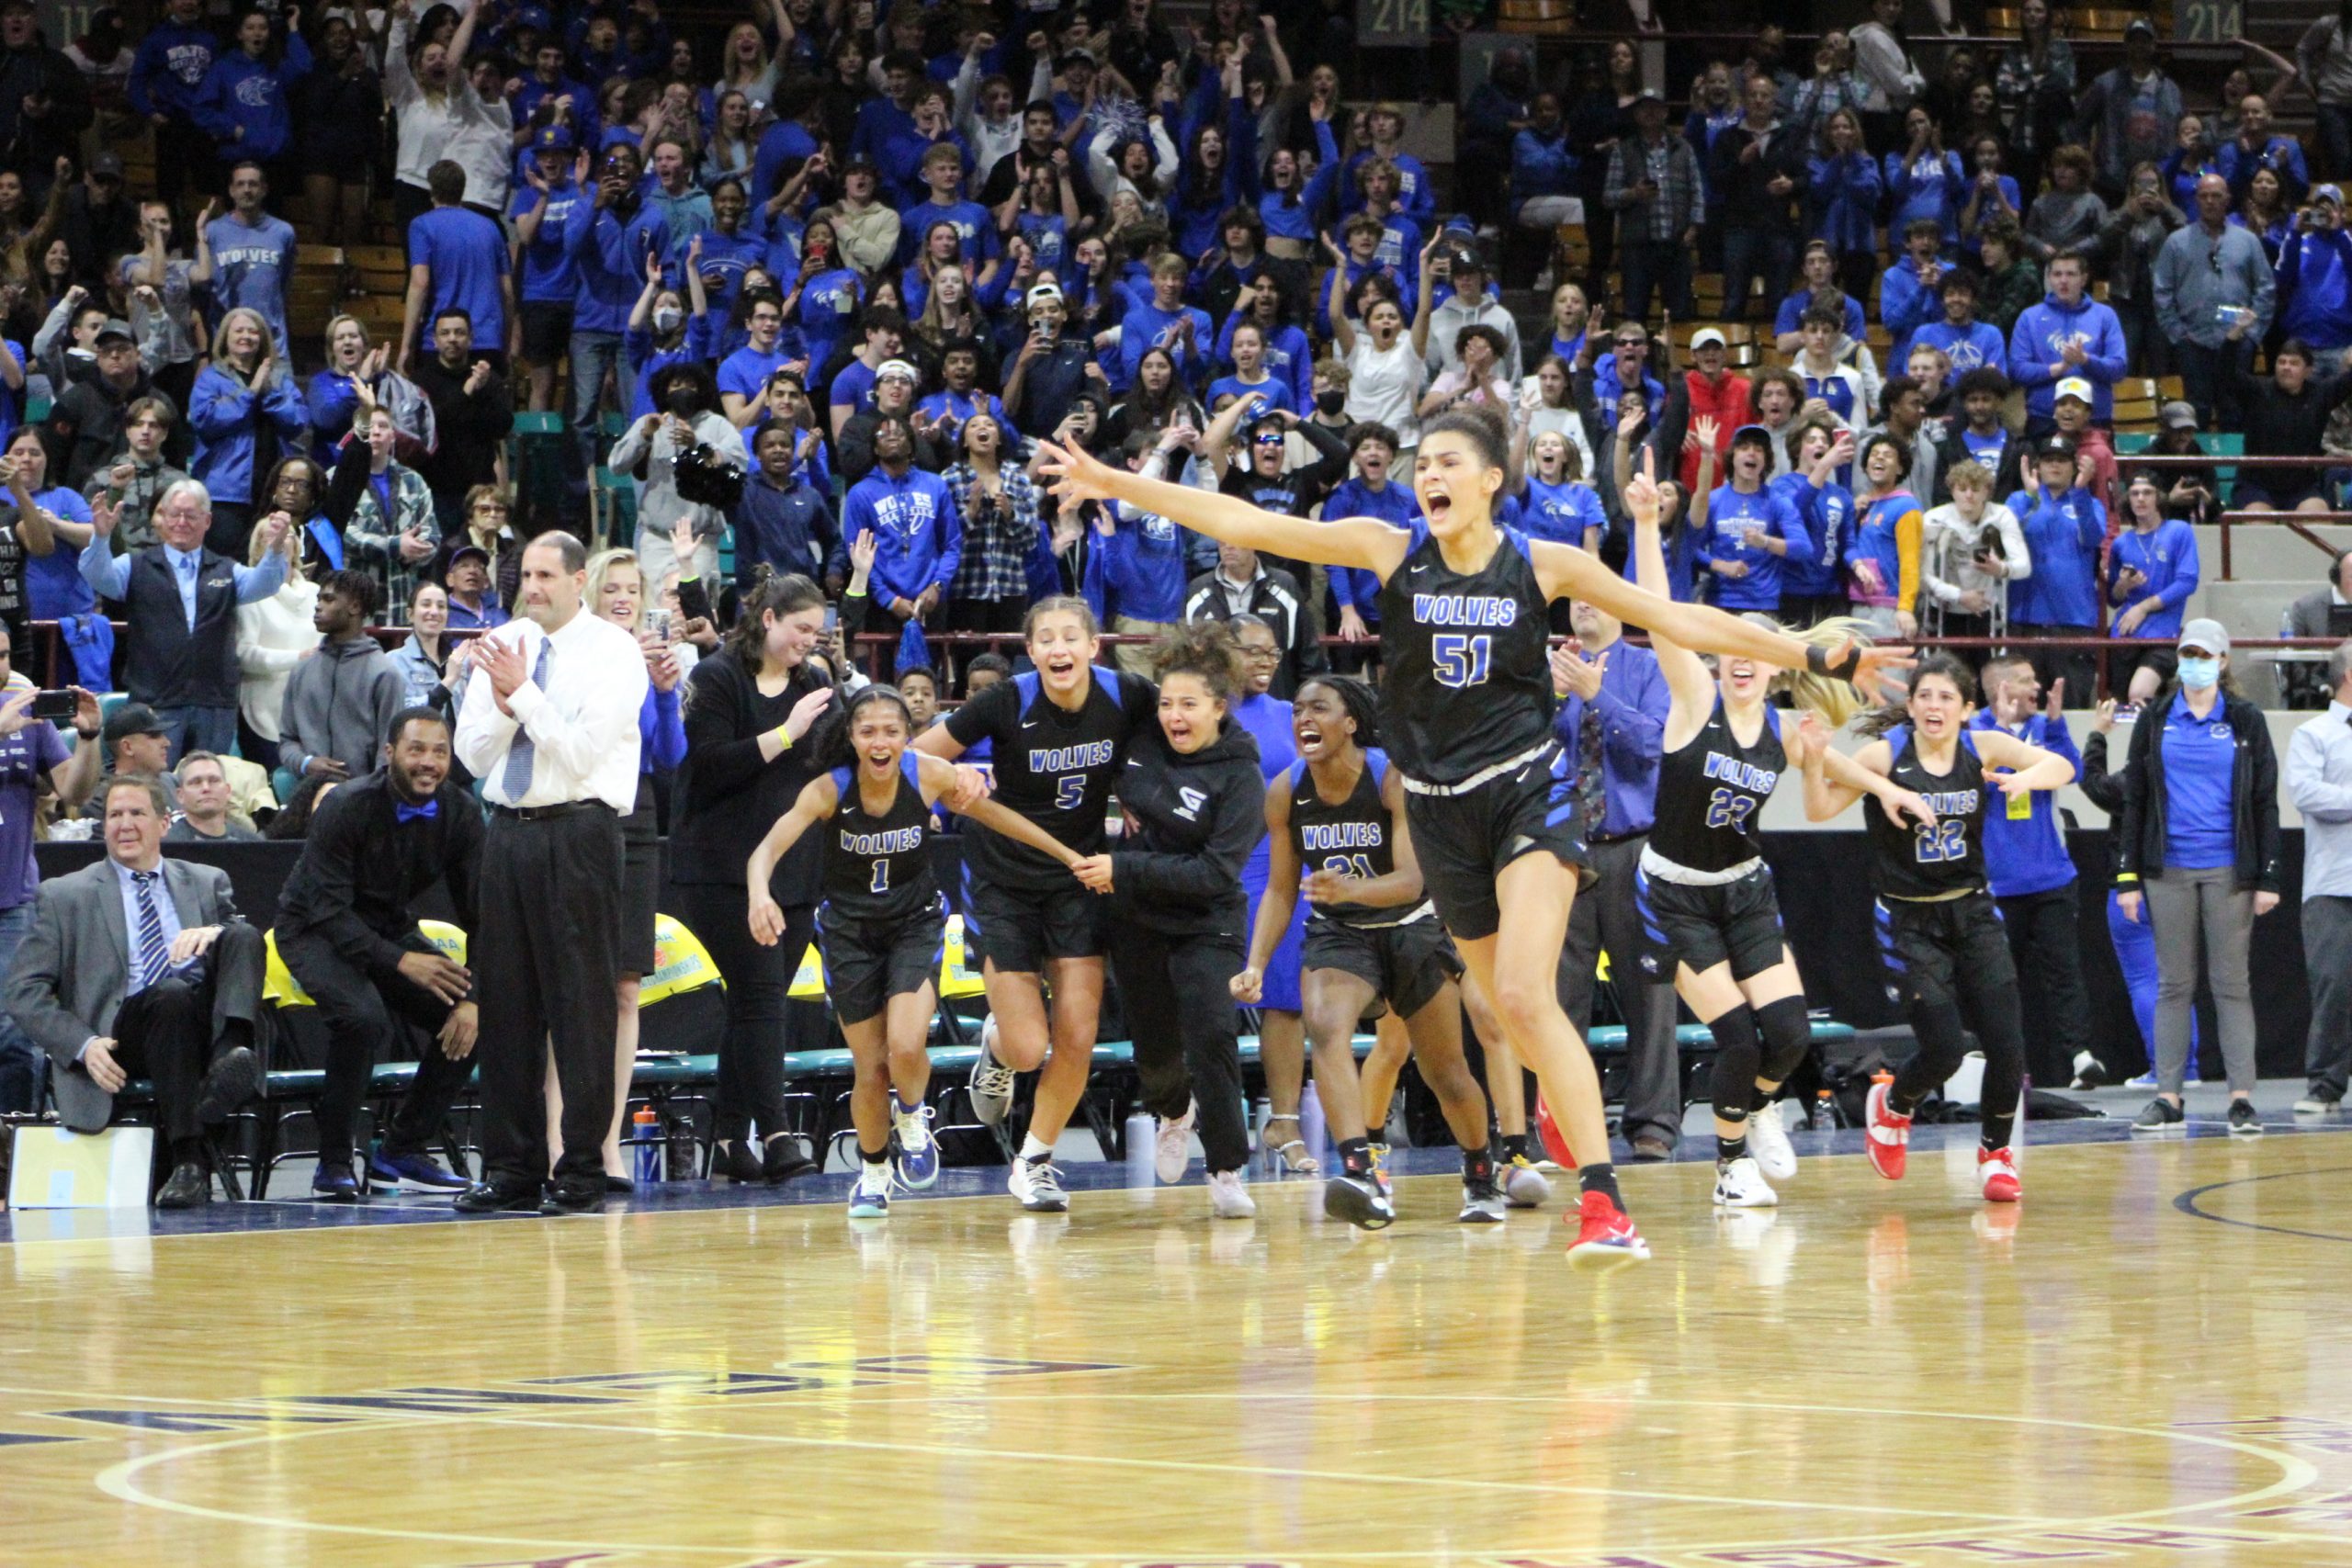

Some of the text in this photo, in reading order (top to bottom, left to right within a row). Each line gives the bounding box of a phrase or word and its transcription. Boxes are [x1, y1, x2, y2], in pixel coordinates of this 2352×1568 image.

[1372, 0, 1430, 33] 214
[2186, 3, 2242, 42] 214
[217, 248, 279, 266] WOLVES
[1413, 593, 1517, 626] WOLVES
[1432, 634, 1491, 688] 51
[1029, 739, 1114, 772] WOLVES
[1703, 750, 1777, 795] WOLVES
[1055, 774, 1088, 809] 5
[1905, 788, 1979, 816] OLVES
[840, 825, 922, 855] WOLVES
[1301, 822, 1383, 851] WOLVES
[1914, 819, 1967, 863] 22
[870, 858, 889, 894] 1
